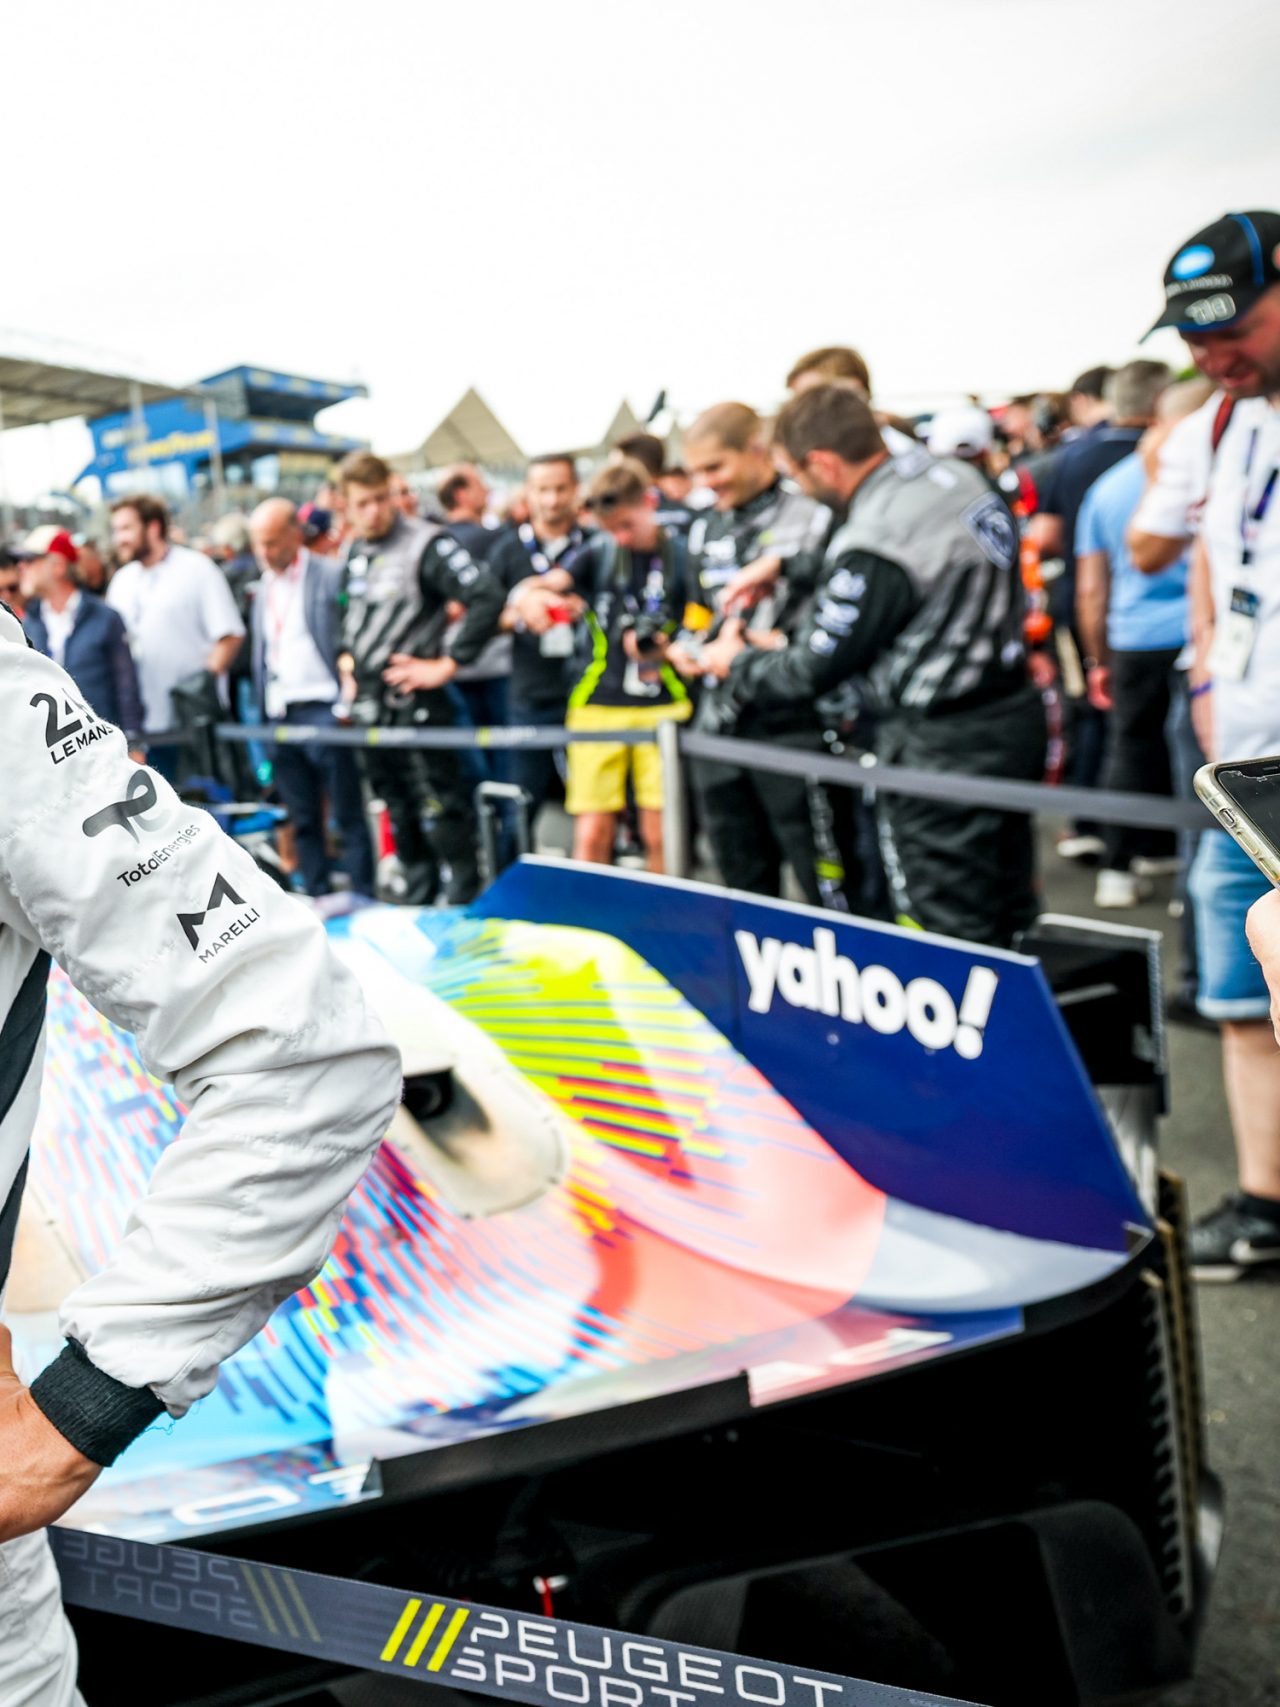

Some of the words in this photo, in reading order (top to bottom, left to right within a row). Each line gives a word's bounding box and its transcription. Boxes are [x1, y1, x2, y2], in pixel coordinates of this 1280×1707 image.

[50, 739, 77, 765] LE
[116, 824, 201, 888] TotalEnergies
[198, 907, 261, 964] MARELLI
[734, 926, 1000, 1060] yahoo!
[450, 1646, 697, 1707] SPORT
[470, 1611, 844, 1707] PEUGEOT
